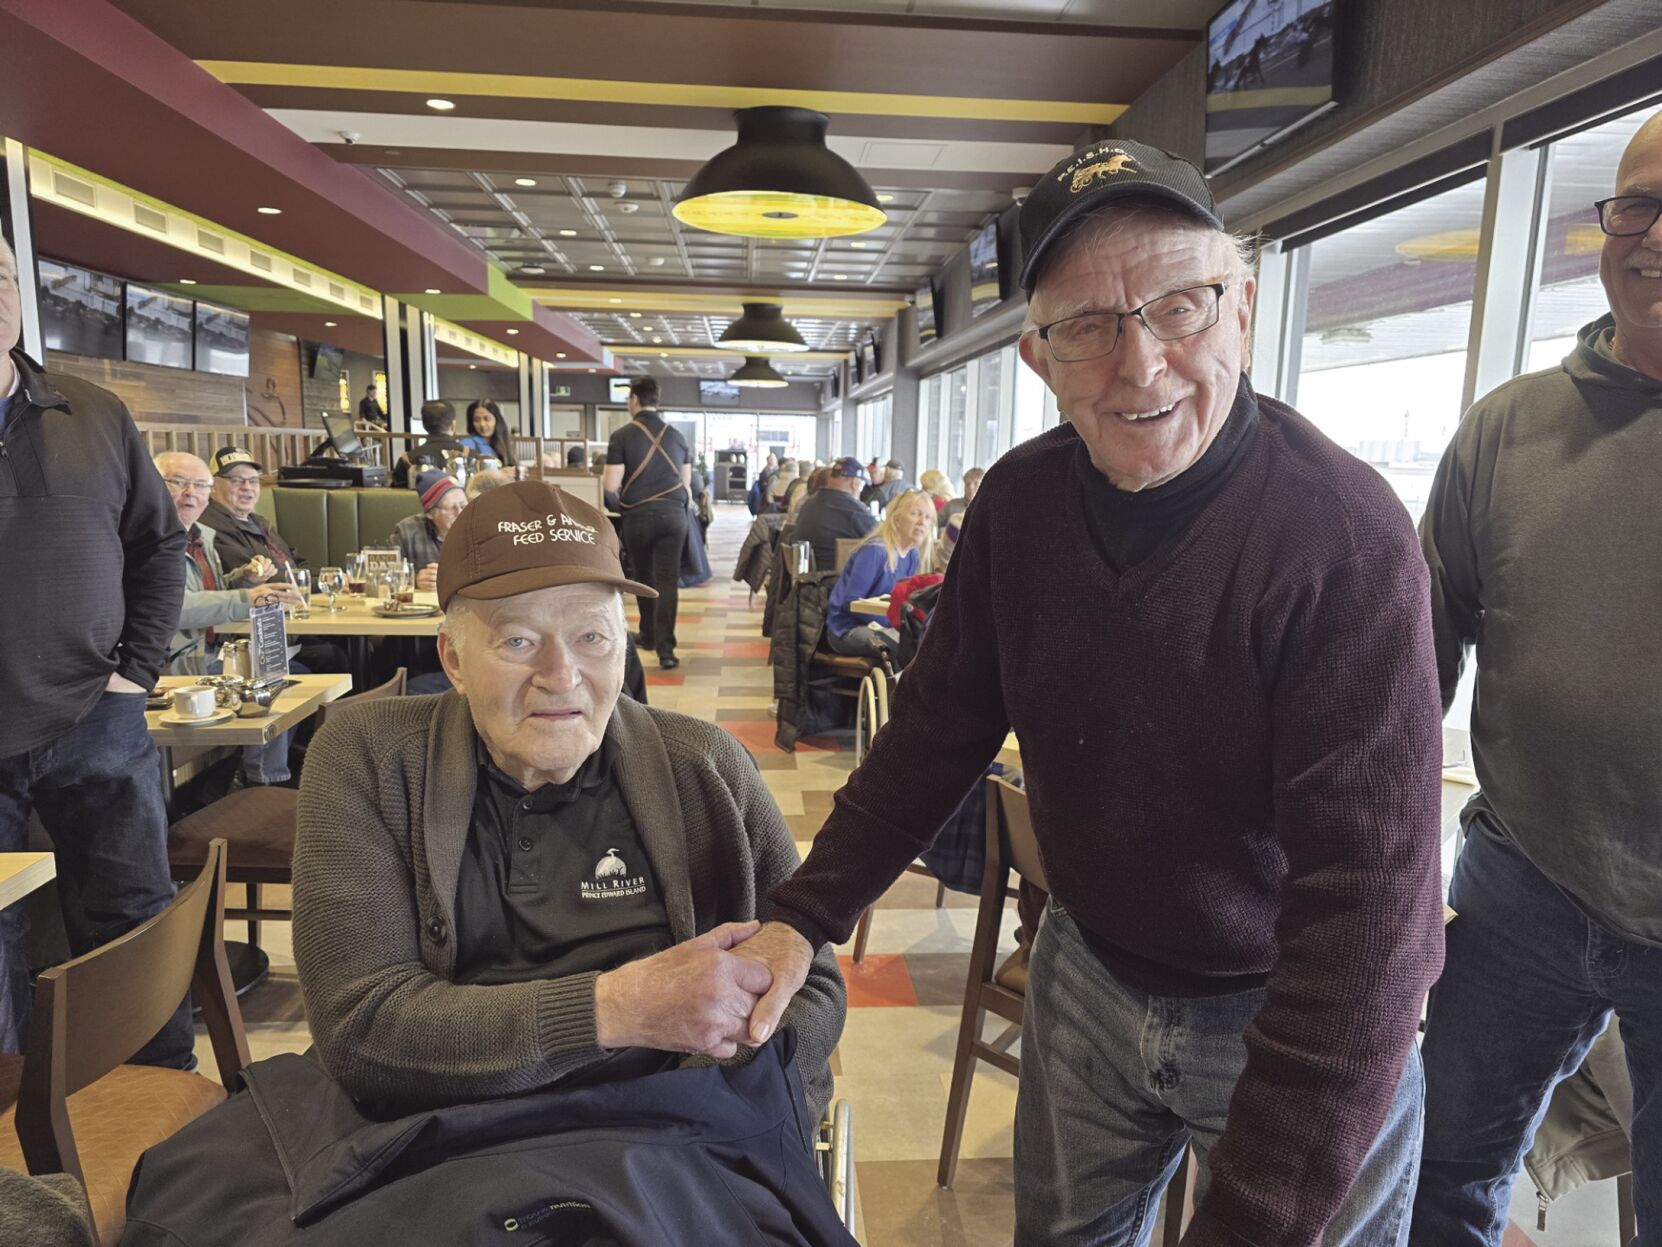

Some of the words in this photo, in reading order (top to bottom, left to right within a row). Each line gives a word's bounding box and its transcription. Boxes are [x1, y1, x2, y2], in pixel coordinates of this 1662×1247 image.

[498, 520, 542, 532] FRASER
[546, 514, 557, 526] &
[513, 532, 545, 546] FEED
[549, 528, 596, 545] SERVICE
[581, 881, 608, 890] MILL
[613, 876, 644, 888] RIVER
[601, 890, 624, 898] EDWARD
[625, 886, 646, 895] ISLAND
